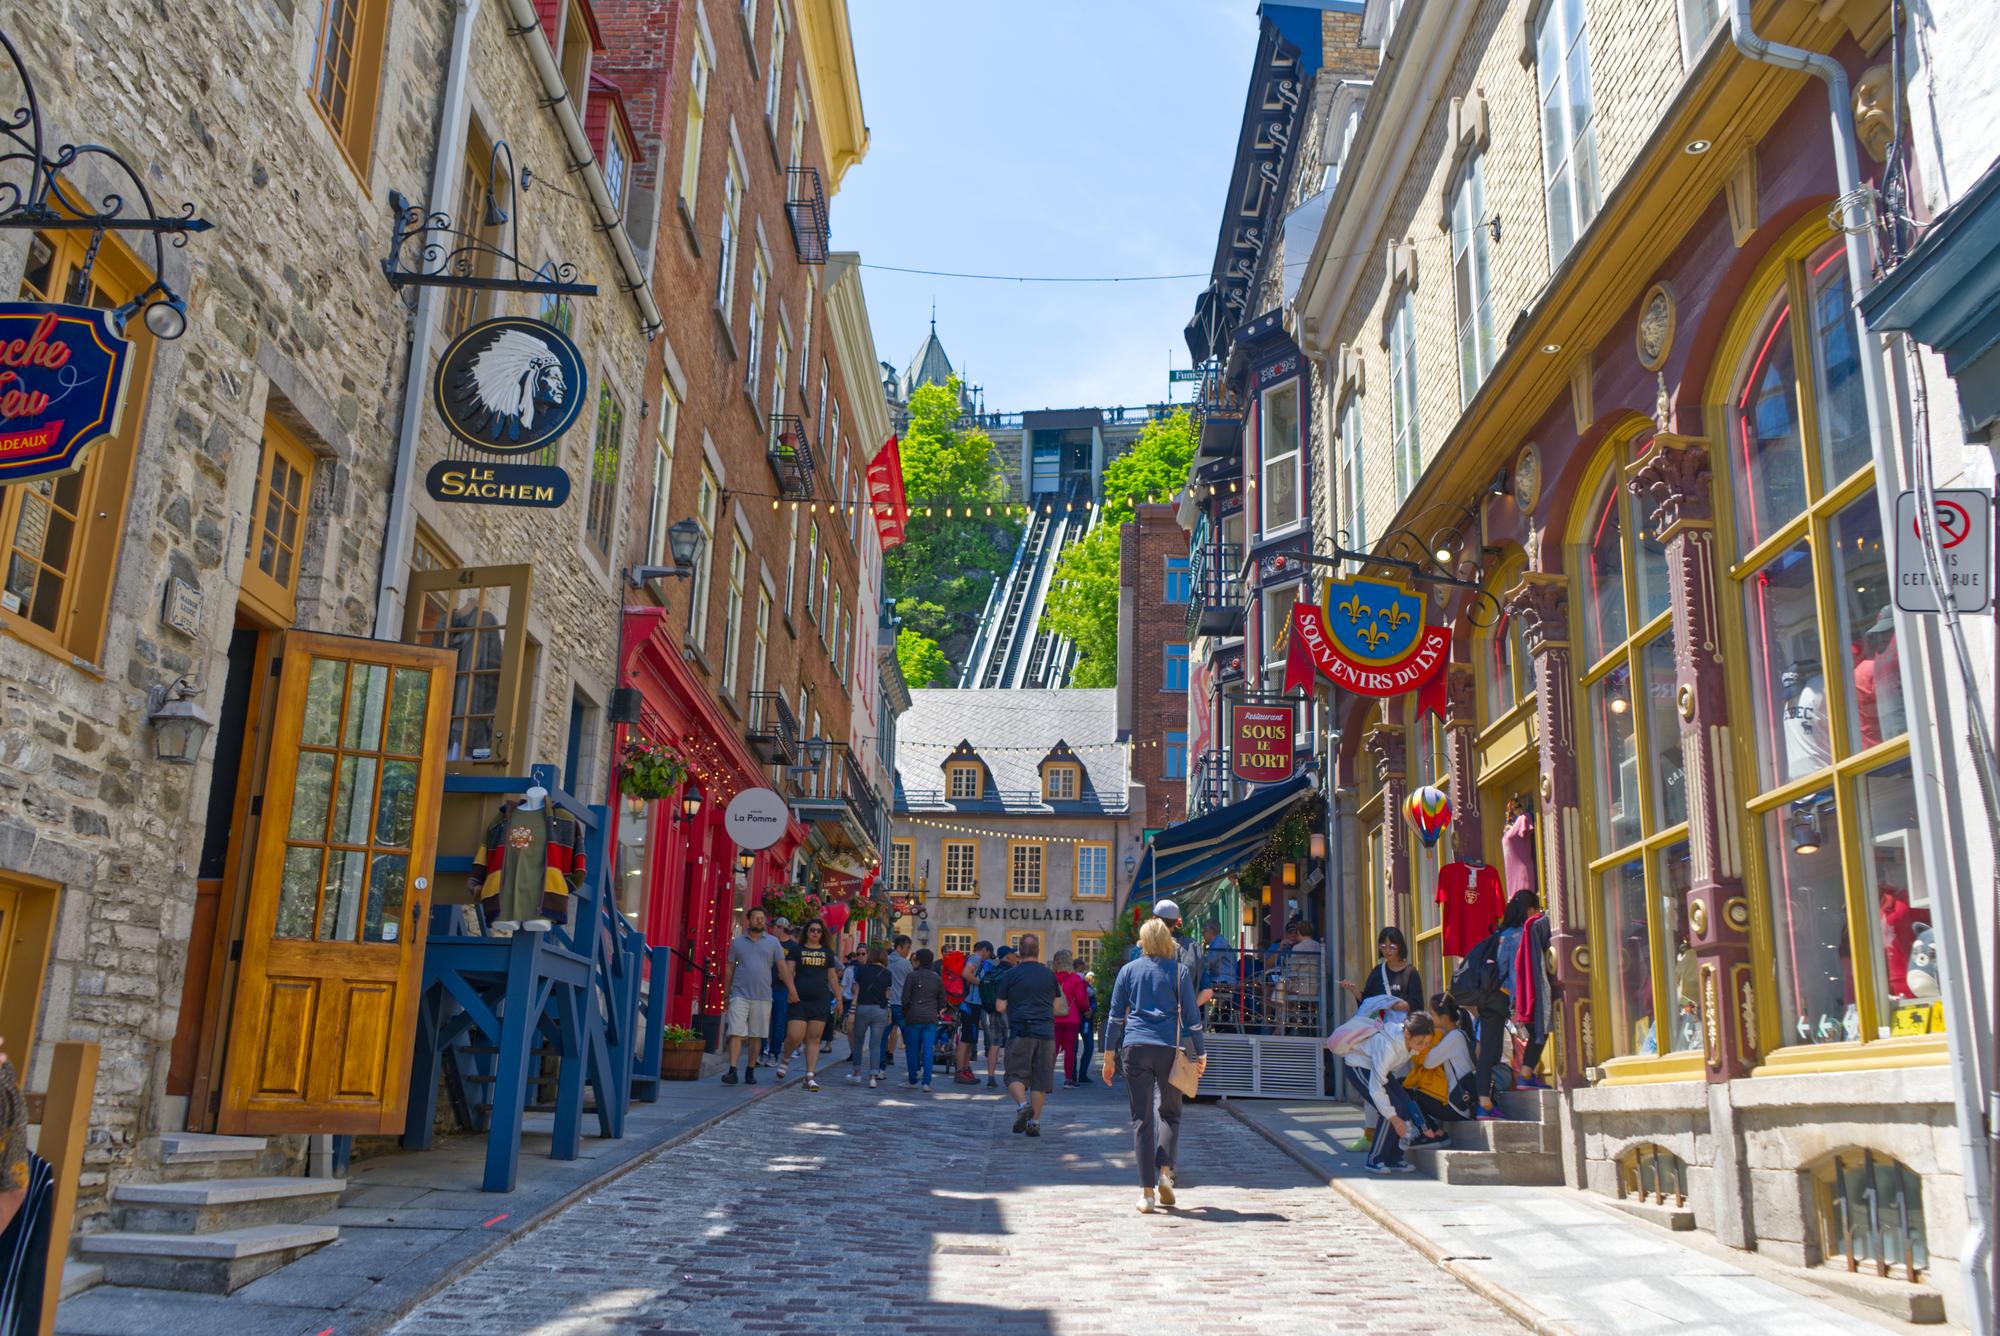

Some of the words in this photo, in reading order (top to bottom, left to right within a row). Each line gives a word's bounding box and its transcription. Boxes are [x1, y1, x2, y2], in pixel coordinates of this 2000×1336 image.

[470, 467, 494, 481] LE
[440, 471, 555, 501] SACHEM
[458, 570, 474, 585] 41
[1903, 573, 1942, 587] CET
[1952, 573, 1979, 587] RUE
[1300, 614, 1393, 689] SOUVENIRS
[1395, 664, 1420, 686] DU
[1416, 634, 1444, 670] LYS
[1244, 711, 1284, 721] Restaurant
[1241, 724, 1286, 740] SOUS
[1257, 740, 1271, 751] LE
[1239, 752, 1289, 768] FORT
[734, 814, 745, 822] La
[747, 814, 777, 823] Pomme
[967, 907, 1085, 922] FUNICULAIRE
